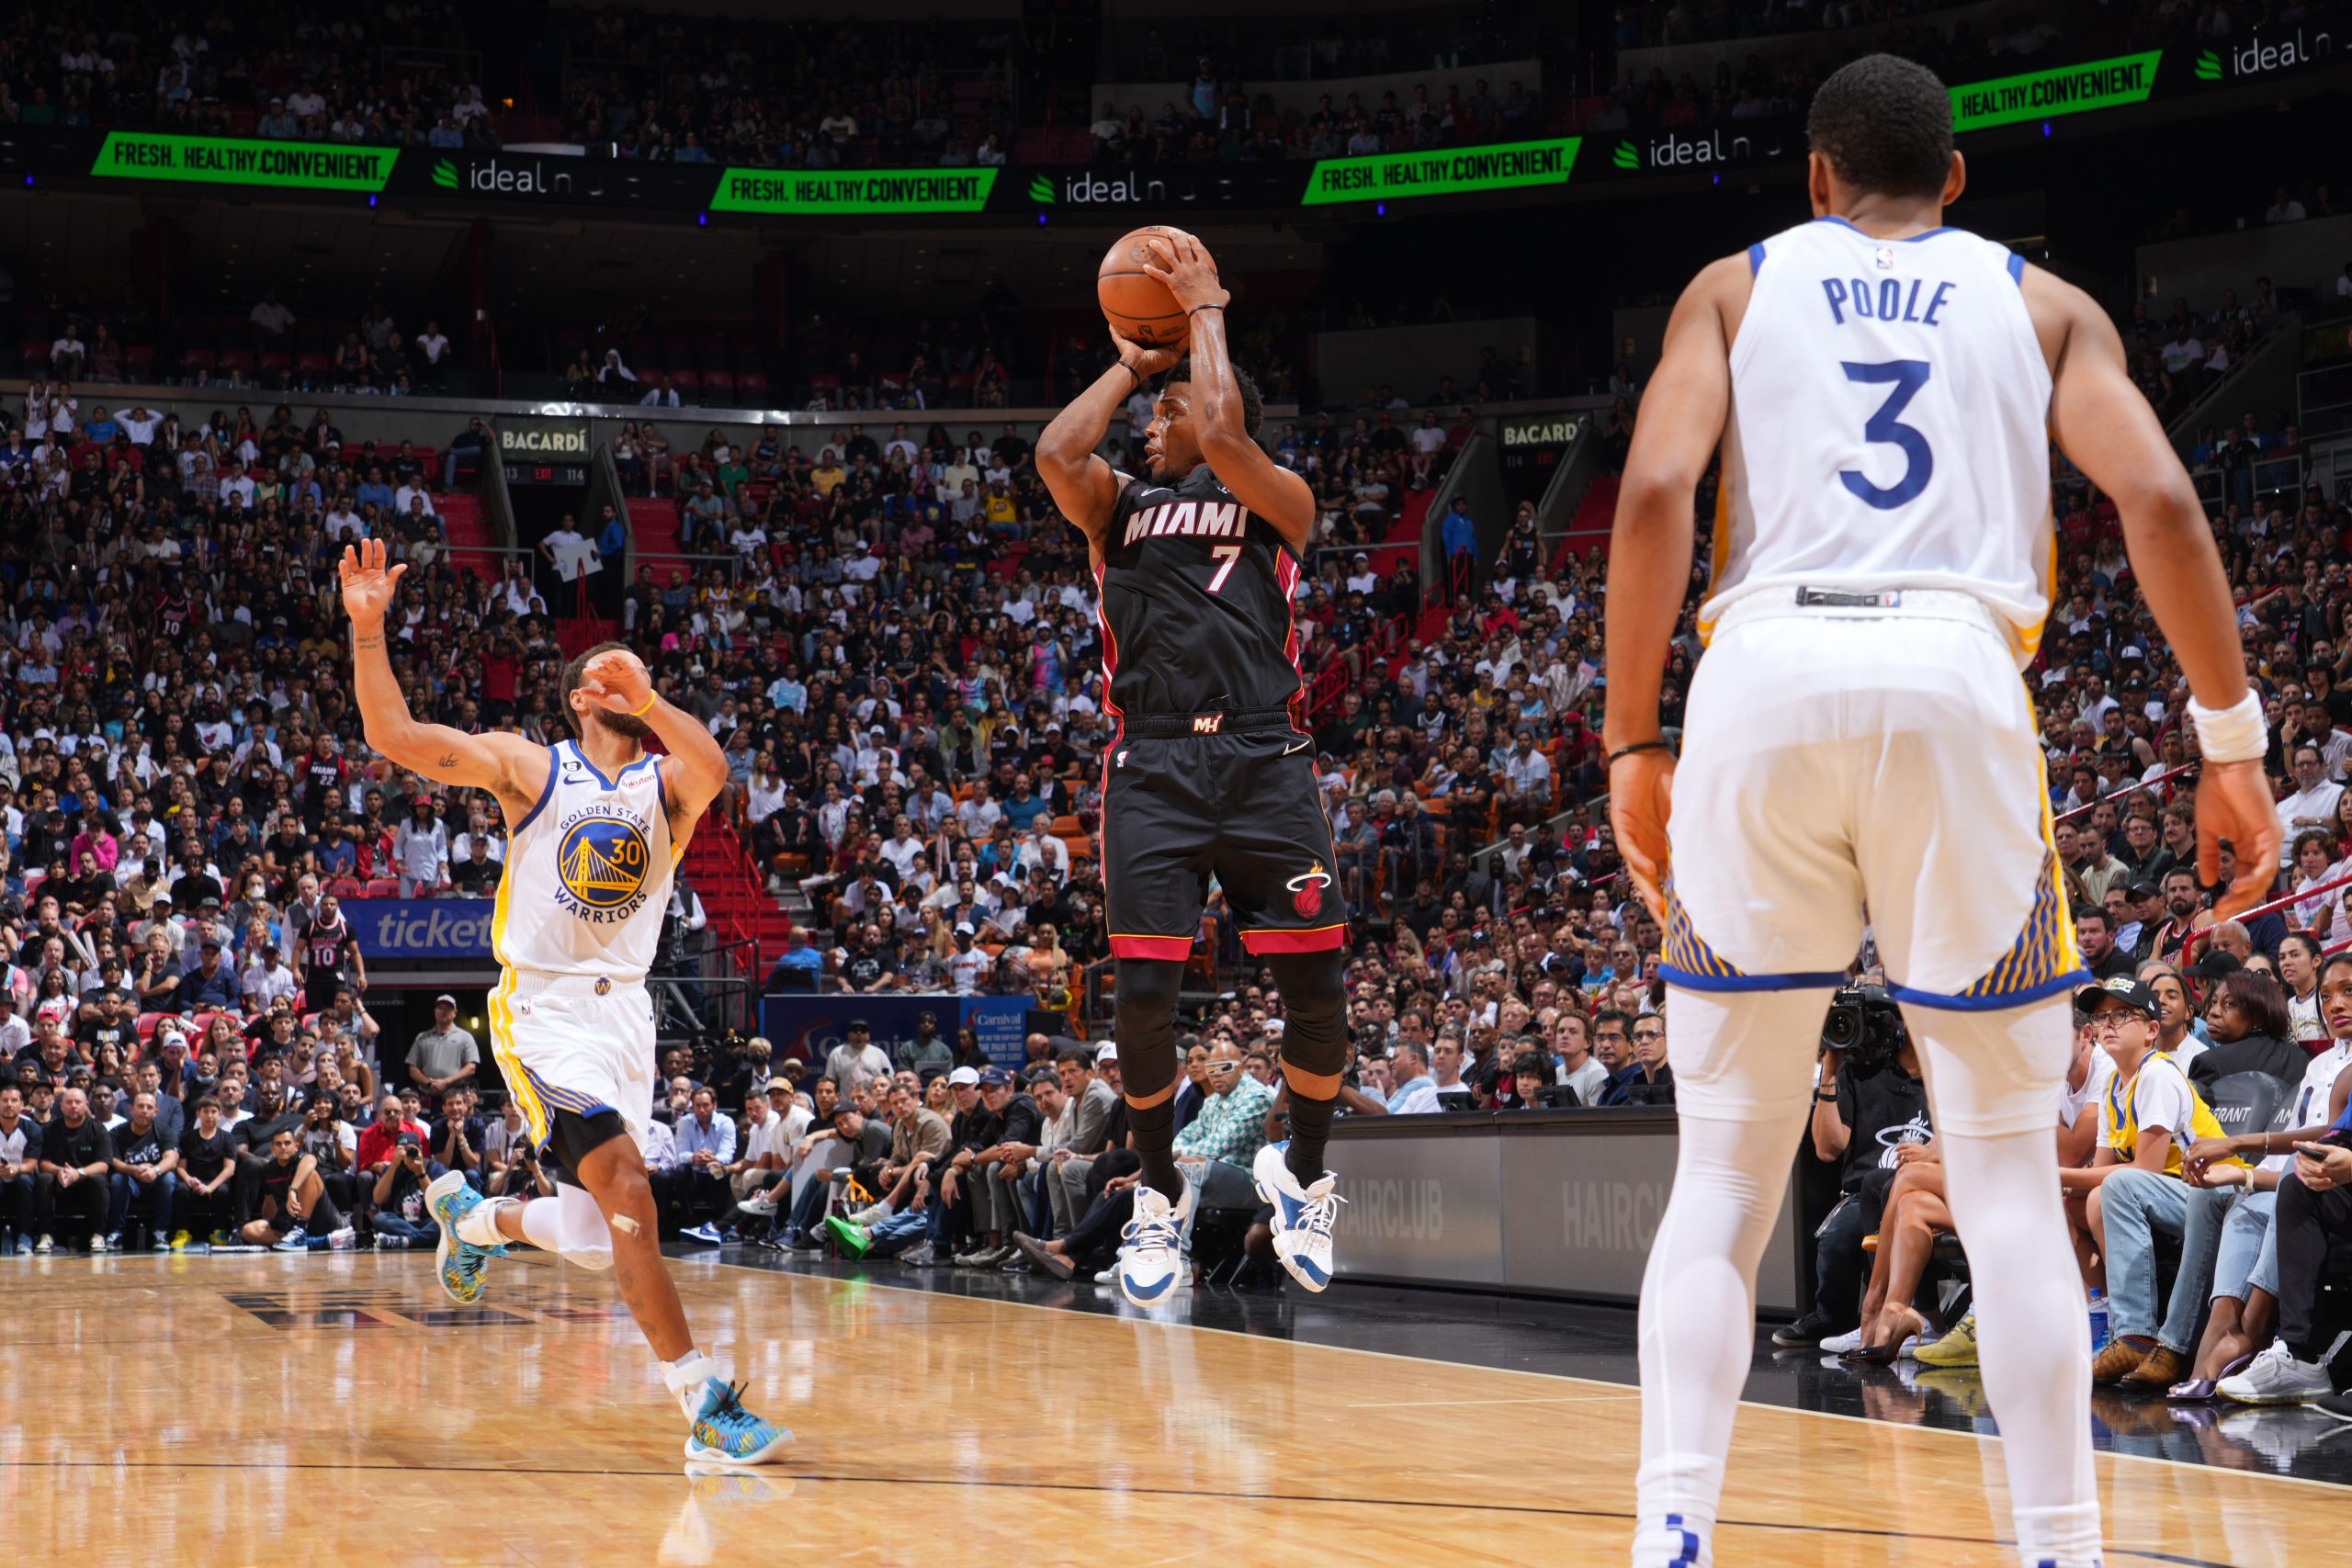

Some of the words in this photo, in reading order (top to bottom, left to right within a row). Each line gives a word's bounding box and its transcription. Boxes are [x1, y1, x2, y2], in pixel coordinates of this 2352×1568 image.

[2031, 62, 2149, 107] CONVENIENT.
[114, 142, 176, 167] FRESH.
[185, 146, 261, 172] HEALTHY.
[261, 150, 385, 180] CONVENIENT.
[1322, 168, 1377, 191] FRESH.
[1384, 160, 1453, 186] HEALTHY.
[1453, 147, 1568, 181] CONVENIENT.
[731, 177, 789, 201] FRESH.
[796, 180, 867, 202] HEALTHY.
[867, 176, 985, 202] CONVENIENT.
[1821, 277, 1957, 326] POOLE
[503, 428, 586, 452] BACARDÍ
[1504, 417, 1584, 446] BACARD
[1839, 359, 1933, 510] 3
[567, 468, 583, 481] 114
[1123, 501, 1250, 548] MIAMI
[1205, 544, 1243, 593] 7
[164, 620, 180, 635] 10
[311, 765, 337, 775] MIAMI
[320, 775, 334, 786] 22
[560, 806, 611, 829] GOLDEN
[617, 807, 650, 835] STATE
[609, 838, 640, 865] 30
[554, 886, 647, 923] WARRIORS
[314, 949, 334, 966] 10
[978, 1013, 1021, 1025] Carnival
